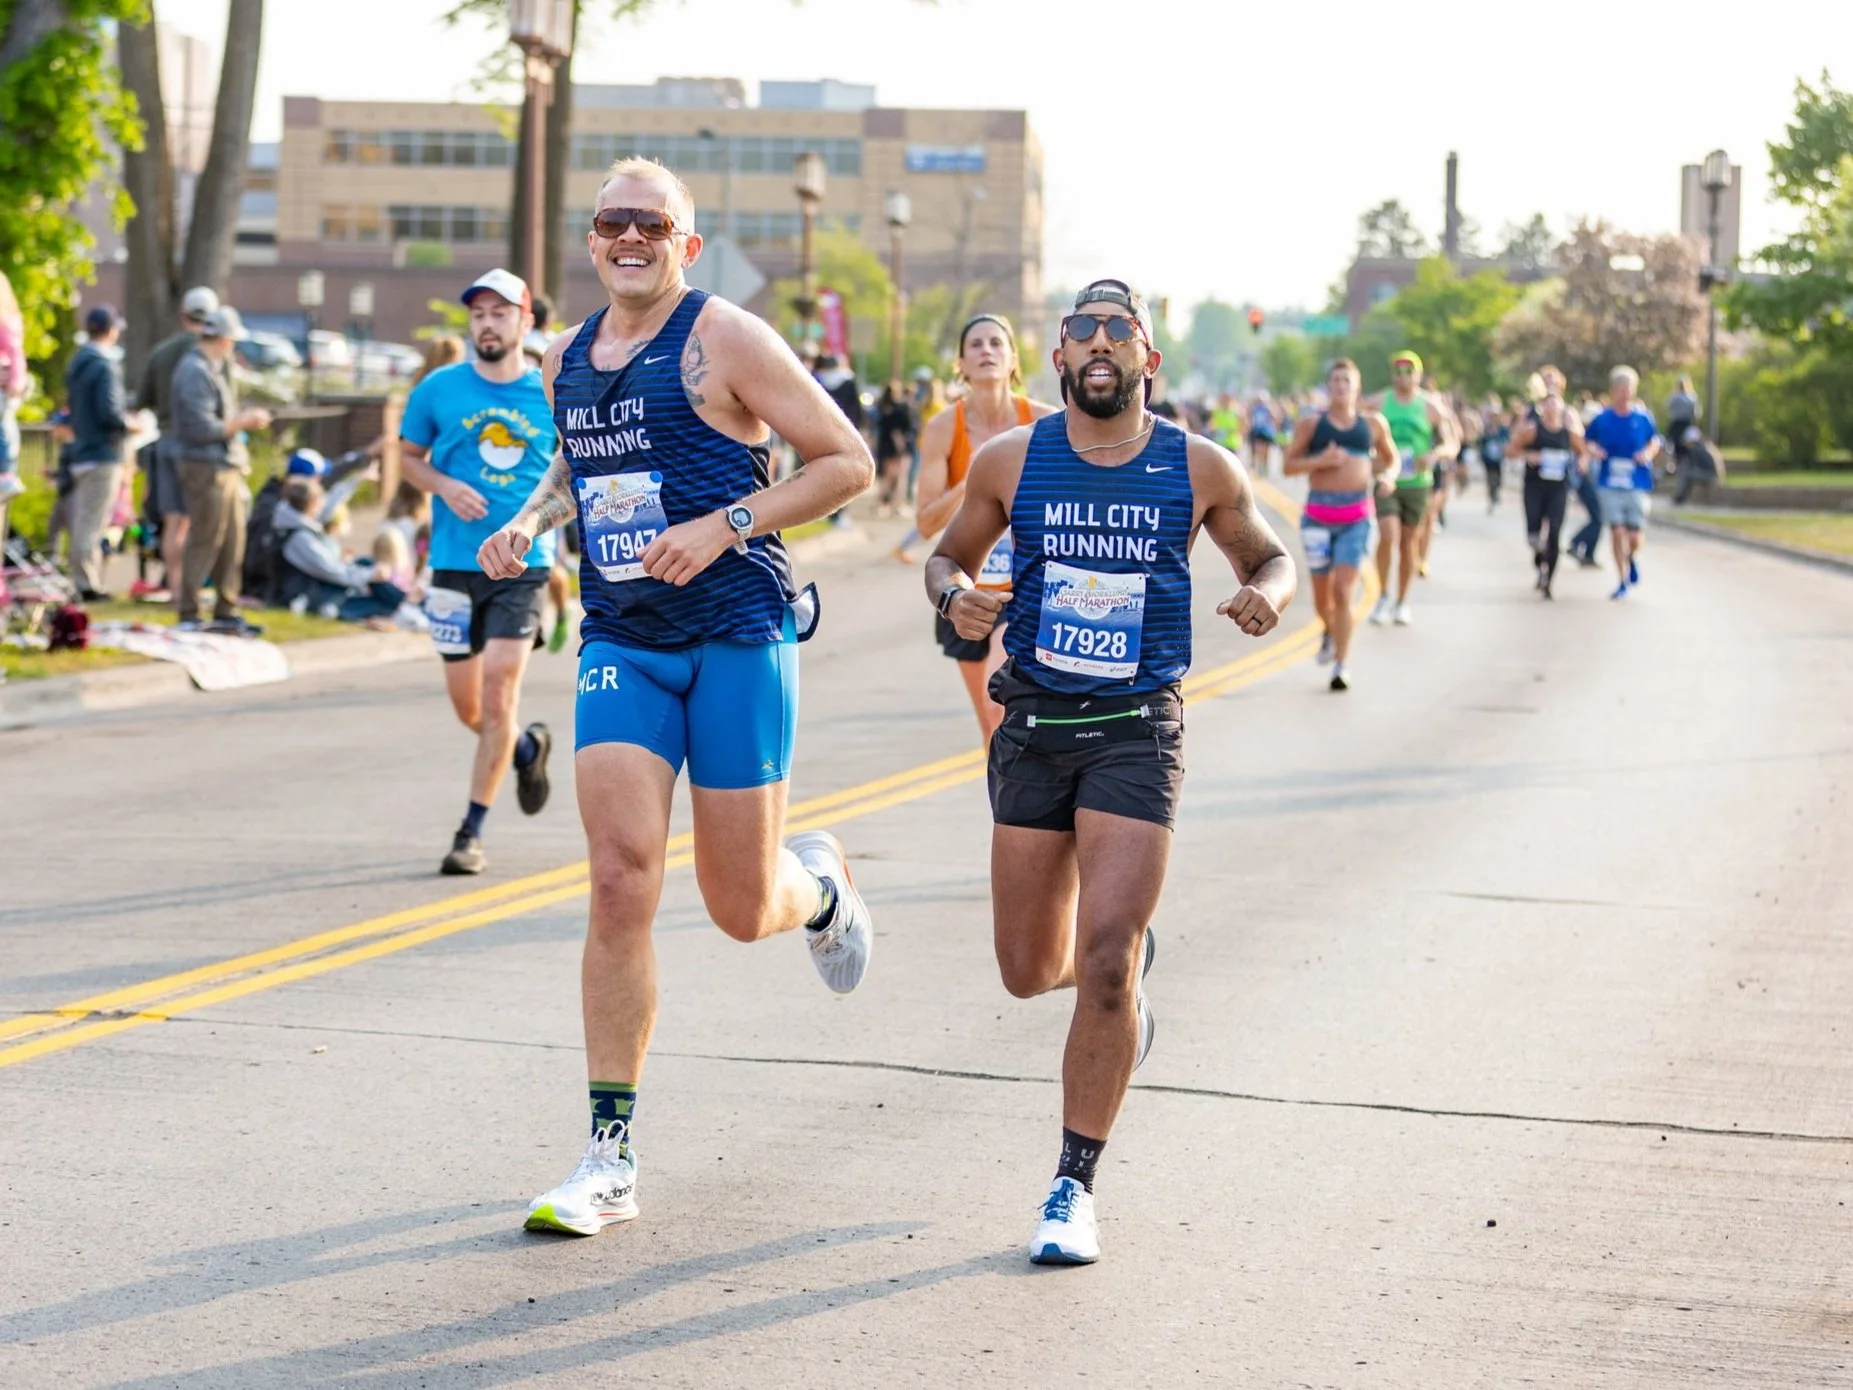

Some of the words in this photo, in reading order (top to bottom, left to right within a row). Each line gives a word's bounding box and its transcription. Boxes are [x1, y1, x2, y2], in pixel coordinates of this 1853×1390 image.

[566, 406, 606, 431] MILL
[610, 397, 644, 426] CITY
[566, 428, 652, 458] RUNNING
[1045, 503, 1100, 526] MILL
[1107, 504, 1160, 531] CITY
[1043, 533, 1158, 561] RUNNING
[1056, 594, 1079, 606] HALF
[1079, 596, 1130, 609] MARATHON
[1052, 622, 1128, 659] 17928
